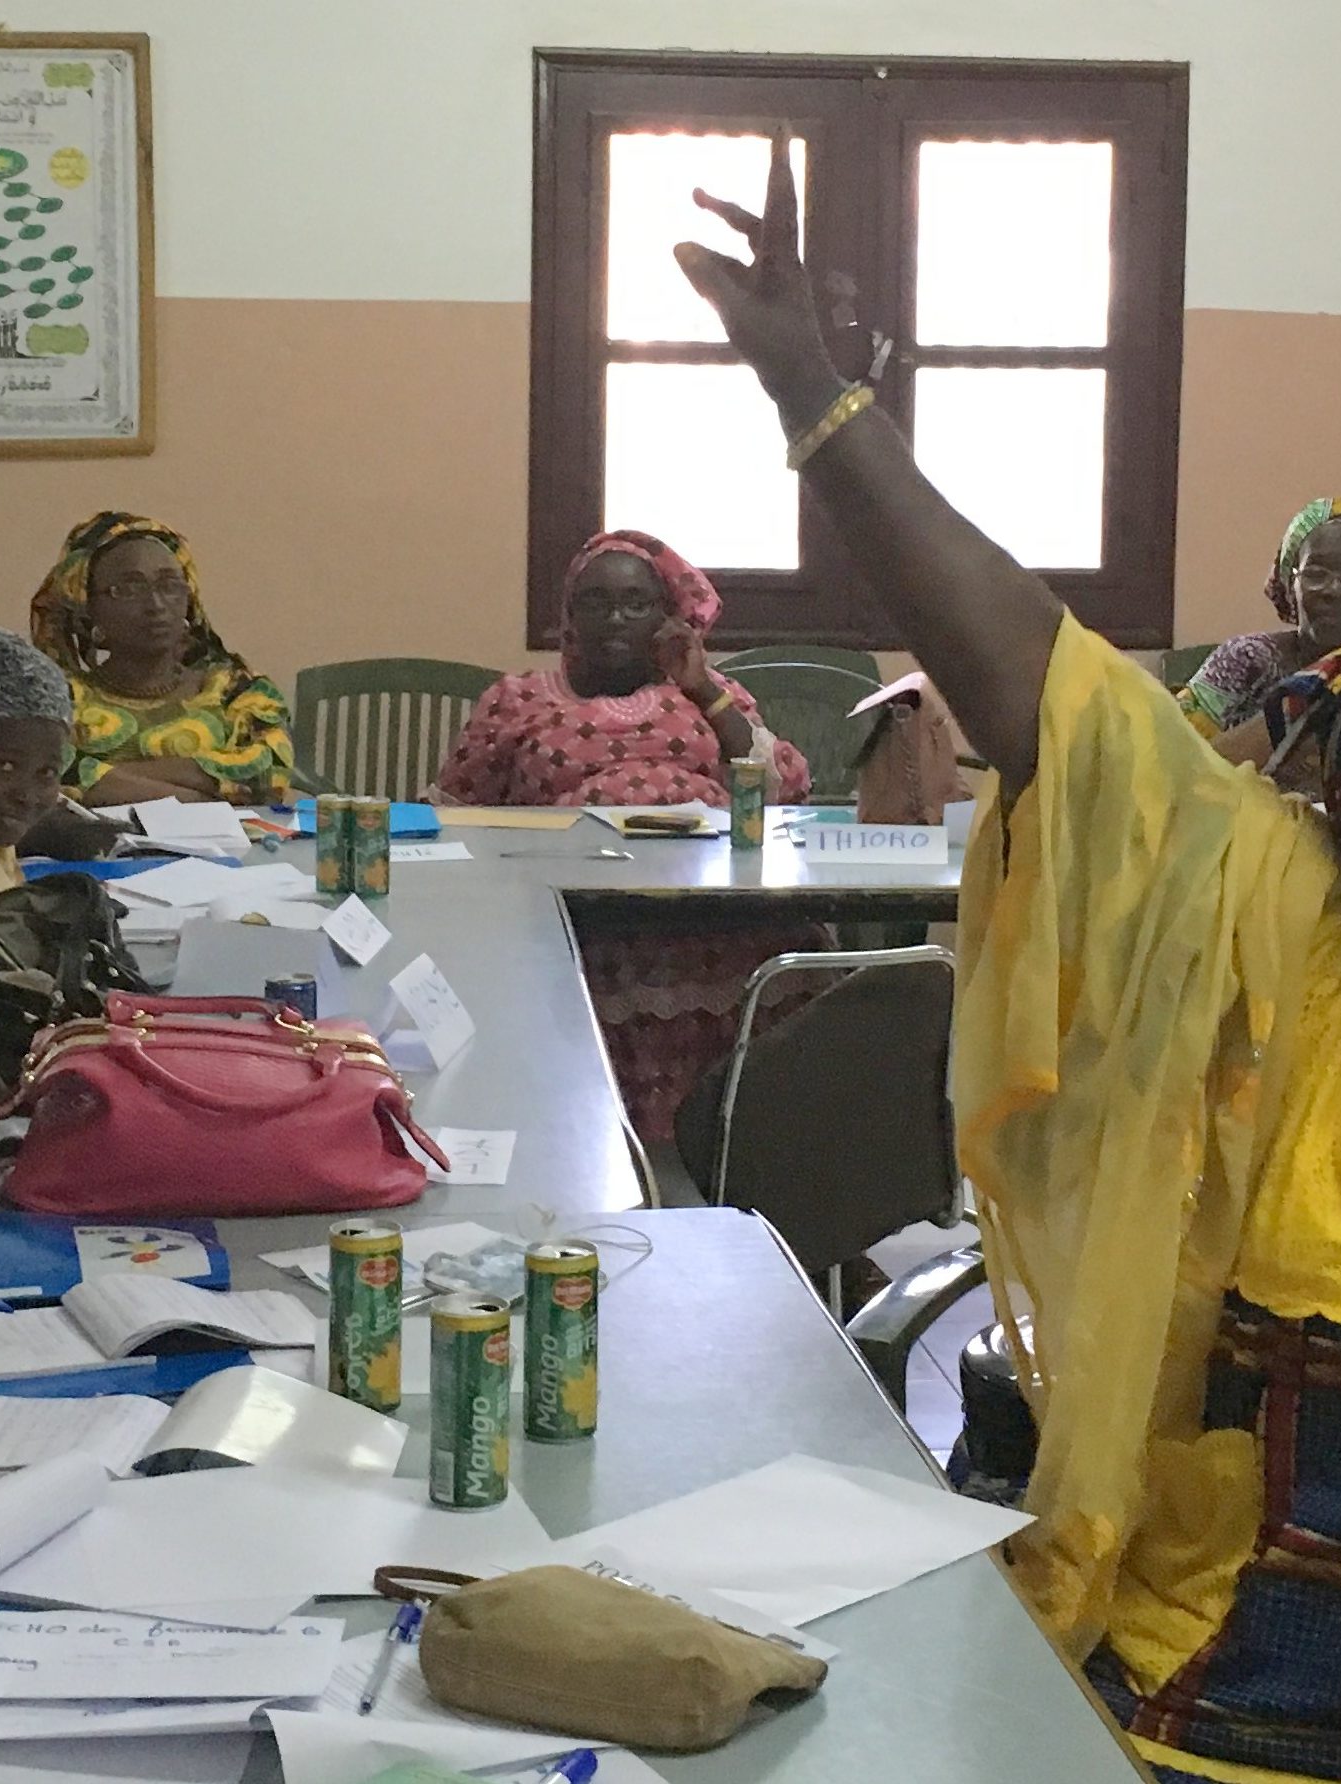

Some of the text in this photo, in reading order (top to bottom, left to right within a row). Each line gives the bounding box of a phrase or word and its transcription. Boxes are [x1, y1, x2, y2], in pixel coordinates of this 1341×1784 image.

[816, 828, 930, 851] THIORO
[535, 1333, 565, 1432] Mango
[466, 1396, 496, 1499] Mango
